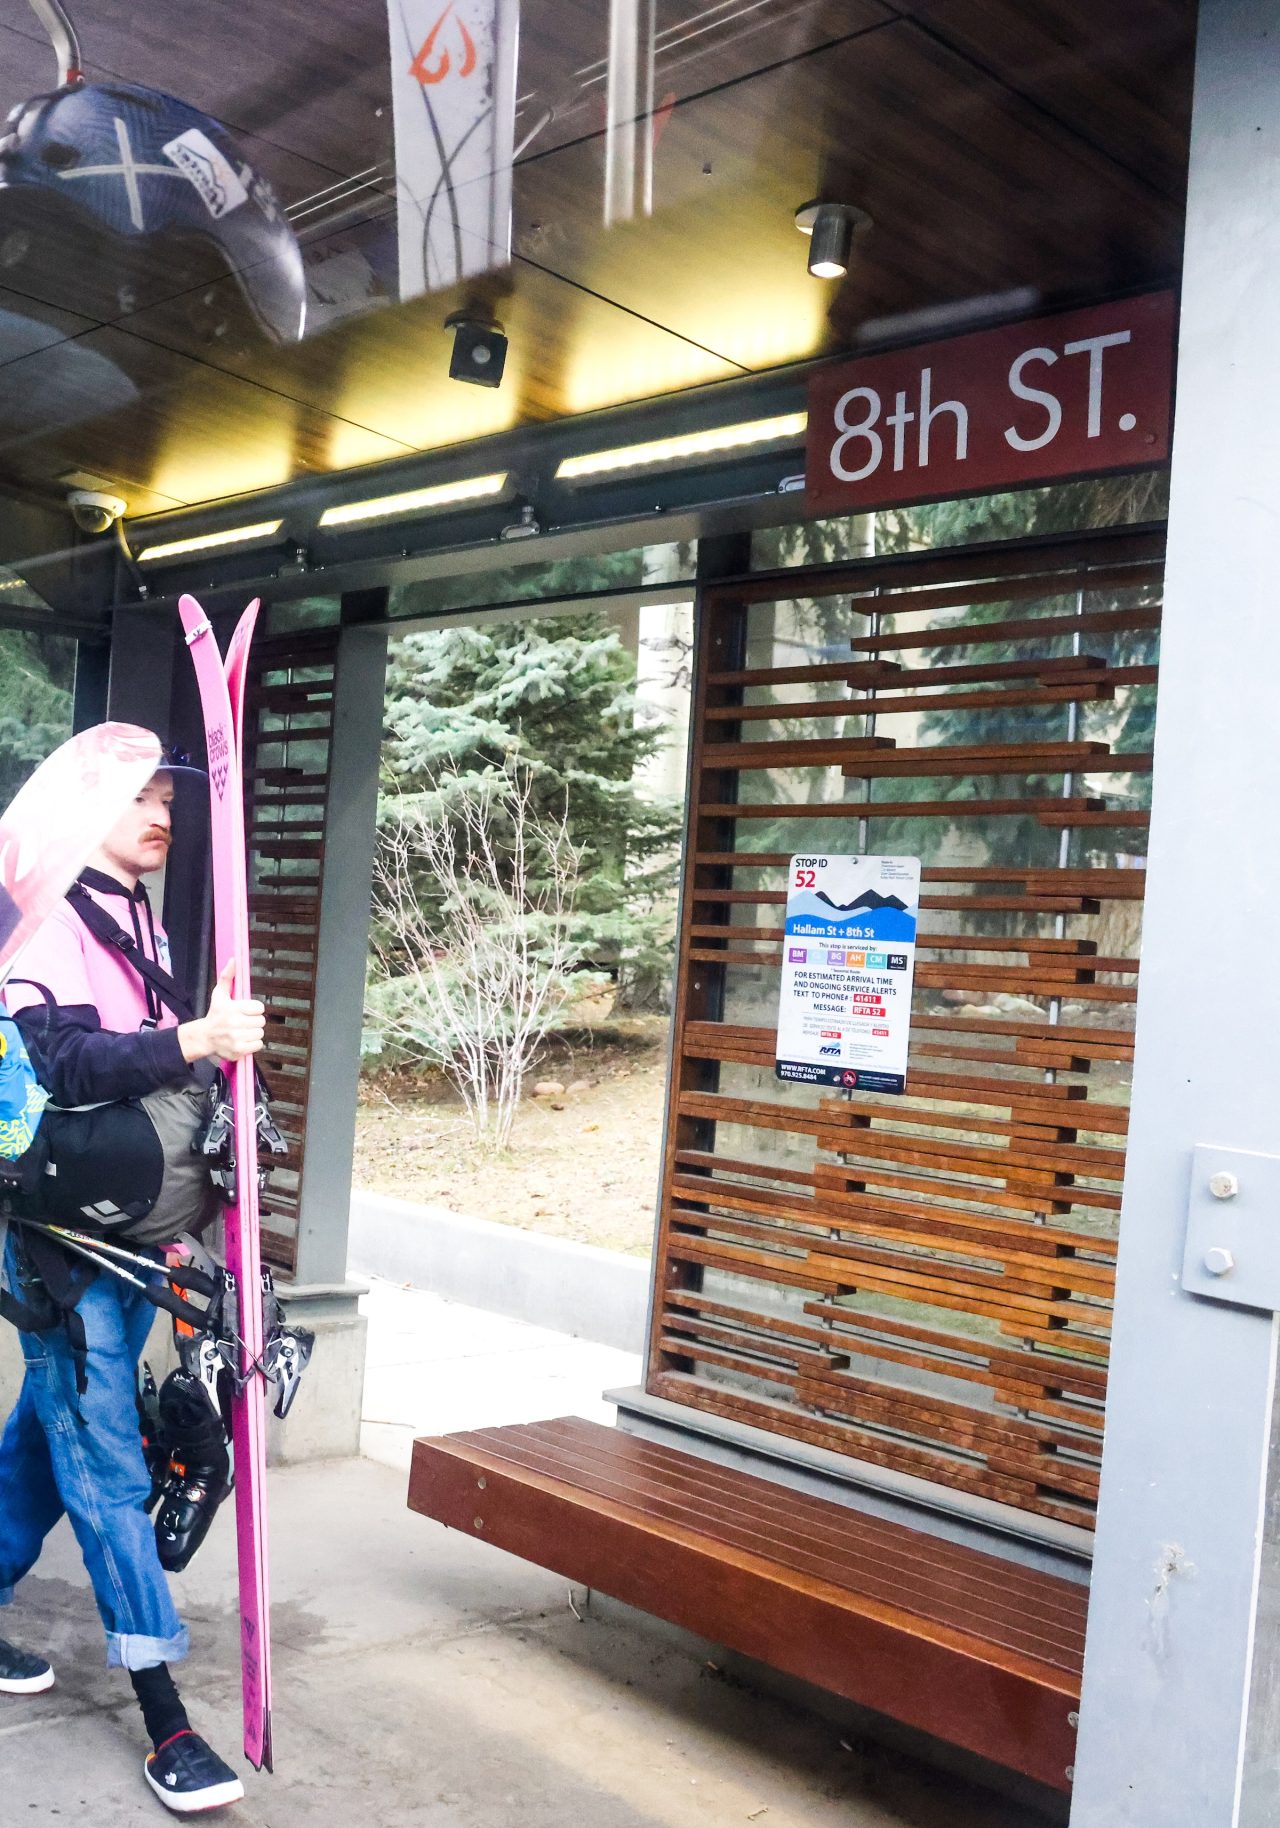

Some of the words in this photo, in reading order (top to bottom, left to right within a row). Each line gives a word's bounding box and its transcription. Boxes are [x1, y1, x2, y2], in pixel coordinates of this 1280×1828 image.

[829, 367, 969, 482] 8th
[1003, 329, 1137, 452] ST.
[796, 858, 816, 868] STOP
[819, 859, 828, 868] ID
[795, 870, 816, 888] 52
[793, 924, 825, 935] Hallam
[827, 926, 837, 936] St
[846, 927, 862, 937] 8th
[864, 928, 875, 938] St
[809, 972, 845, 981] ESTIMATED
[847, 975, 874, 984] ARRIVAL
[794, 980, 808, 988] AND
[810, 982, 841, 991] ONGOING
[843, 985, 869, 993] SERVICE
[871, 987, 897, 995] ALERTS
[855, 995, 877, 1003] 41411
[813, 1003, 847, 1013] MESSAGE:
[854, 1007, 871, 1015] RFTA
[820, 1047, 841, 1055] RFTA
[781, 1064, 826, 1075] WWW.RFTA.COM
